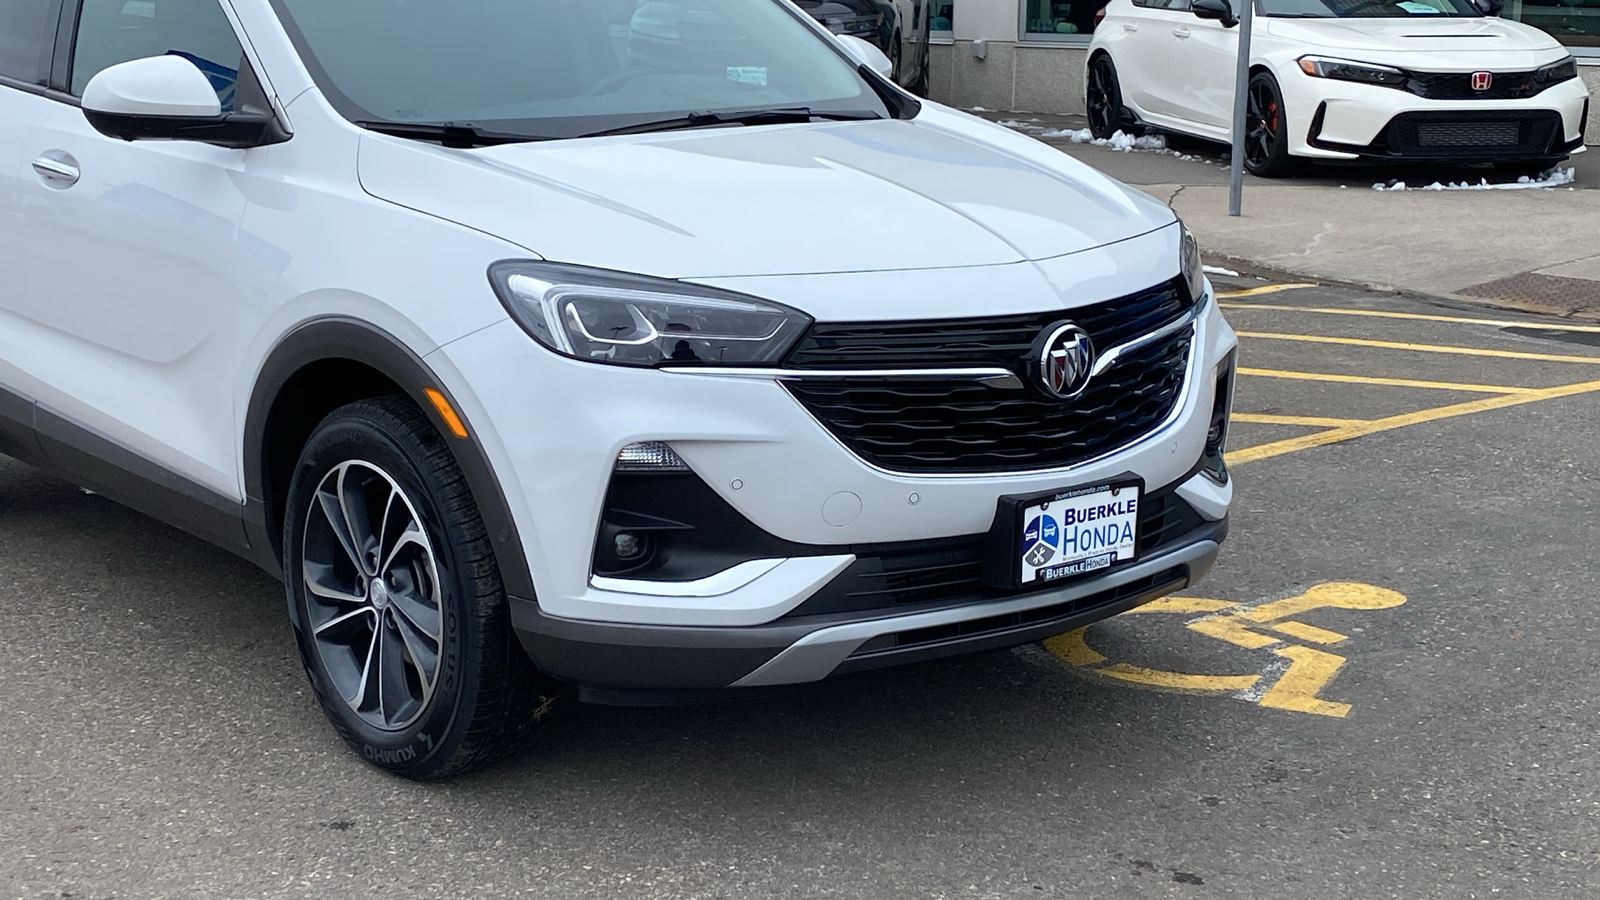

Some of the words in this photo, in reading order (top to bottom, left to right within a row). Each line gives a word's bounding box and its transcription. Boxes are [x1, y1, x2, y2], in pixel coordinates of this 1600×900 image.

[1064, 499, 1137, 526] BUERKLE
[1063, 521, 1134, 556] HONDA
[363, 744, 417, 764] KUMHO
